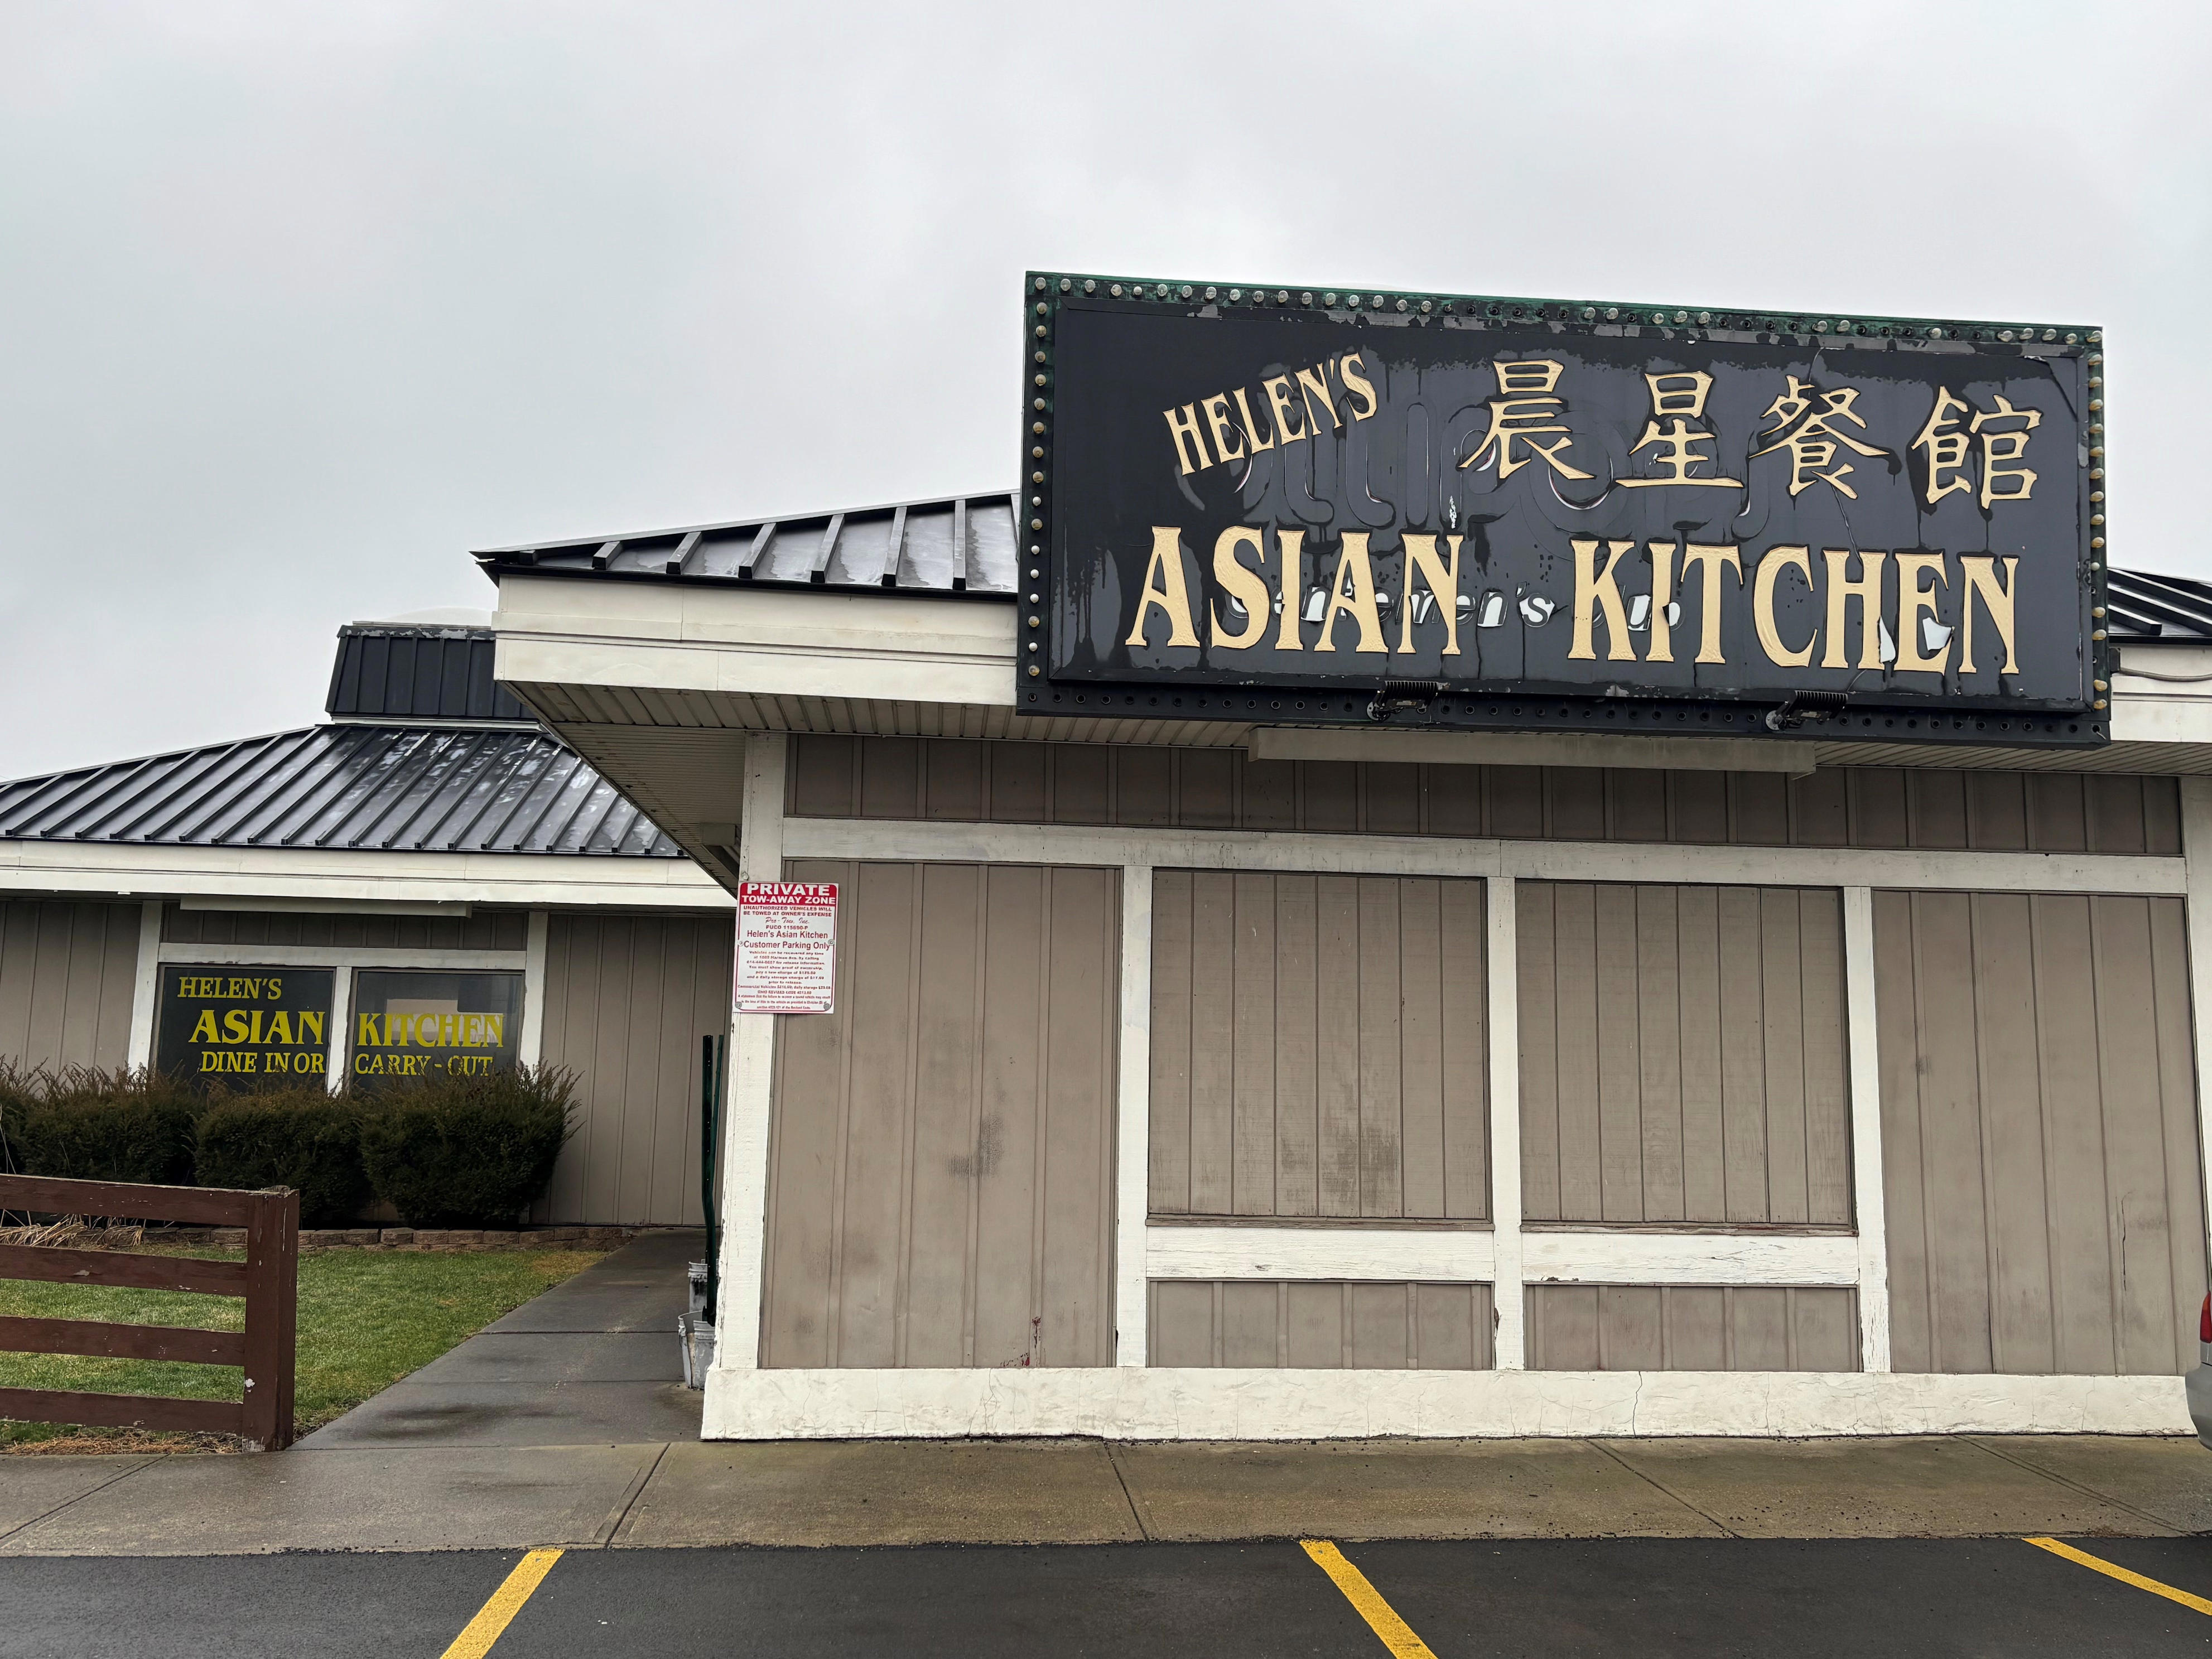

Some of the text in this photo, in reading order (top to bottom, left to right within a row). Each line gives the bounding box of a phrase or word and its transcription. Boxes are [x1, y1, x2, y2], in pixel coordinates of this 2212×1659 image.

[1164, 353, 1377, 475] HELEN'S
[1460, 359, 2041, 509] 晨星餐館
[1125, 525, 2020, 674] ASIAN KITCHEN
[741, 895, 836, 905] TOW-AWAY ZONE
[747, 883, 830, 896] PRIVATE
[783, 942, 811, 951] Parking
[813, 942, 830, 951] Only
[177, 977, 282, 1000] HELEN'S
[188, 1009, 504, 1048] ASIAN KITCHEN
[200, 1051, 258, 1073] DINE
[264, 1053, 290, 1073] IN
[293, 1053, 325, 1074] OR
